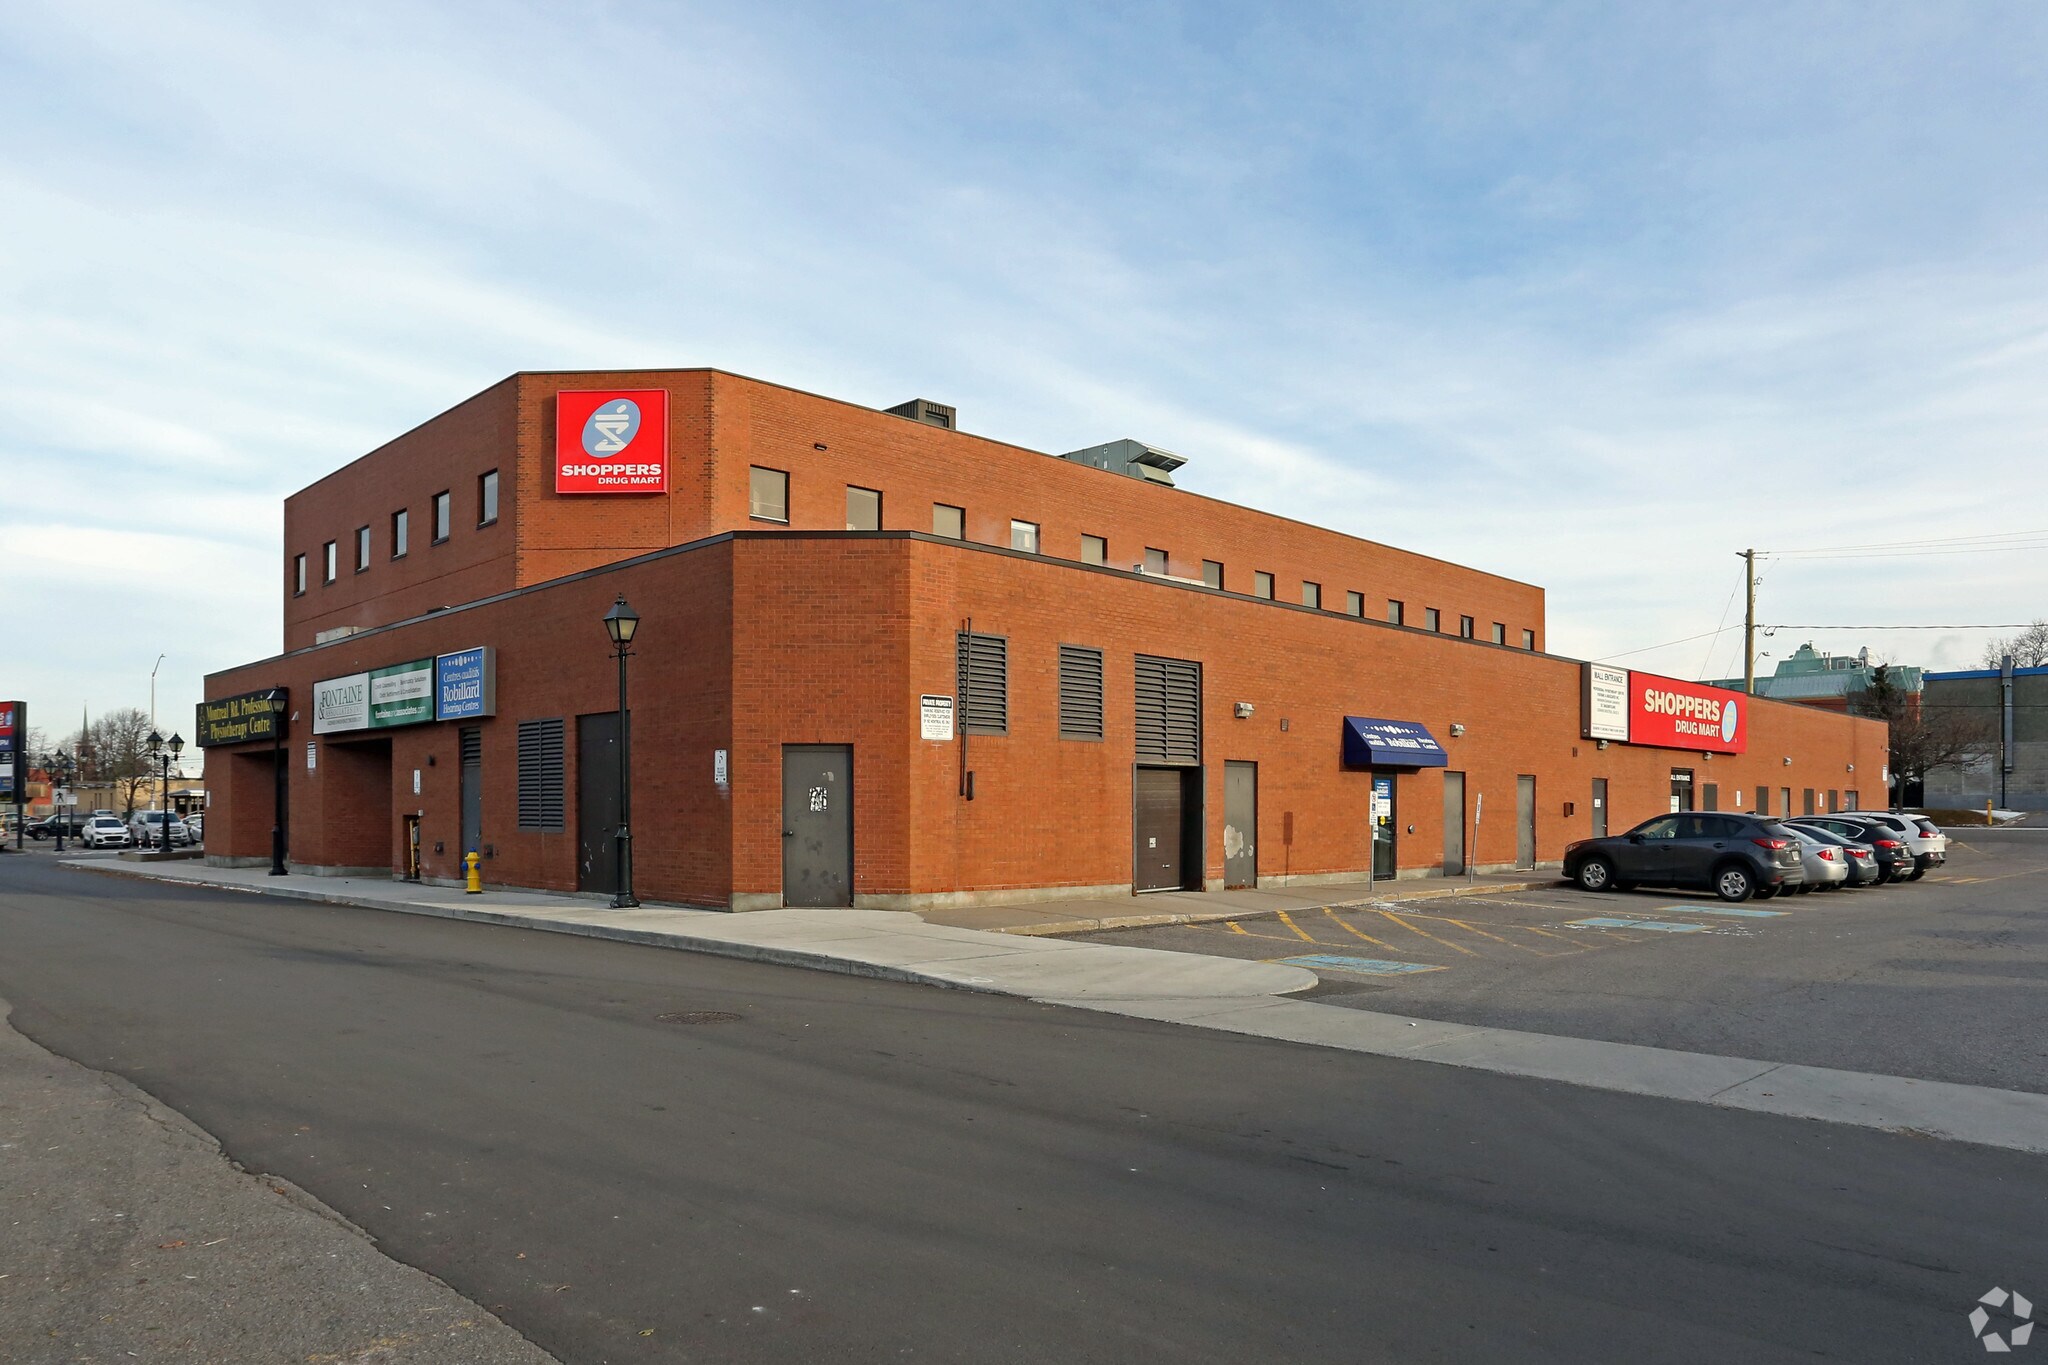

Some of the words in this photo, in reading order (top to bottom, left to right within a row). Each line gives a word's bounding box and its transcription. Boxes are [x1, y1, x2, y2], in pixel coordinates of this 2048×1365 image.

[561, 463, 662, 476] SHOPPERS
[598, 477, 629, 485] DRUG
[630, 476, 662, 484] MART
[443, 672, 462, 682] Centres
[1604, 673, 1623, 684] ENTRANCE
[321, 684, 363, 708] FONTAINE
[443, 680, 480, 702] Robillard
[206, 703, 229, 720] Montreal
[241, 695, 271, 715] Profession
[318, 701, 326, 720] &
[443, 703, 462, 715] Hearing
[462, 701, 480, 711] Centres
[1644, 688, 1721, 722] SHOPPERS
[211, 720, 247, 742] Physiotherapy
[249, 716, 270, 734] Centre
[1675, 719, 1698, 735] DRUG
[1698, 724, 1721, 738] MART
[1385, 738, 1421, 748] Robillard
